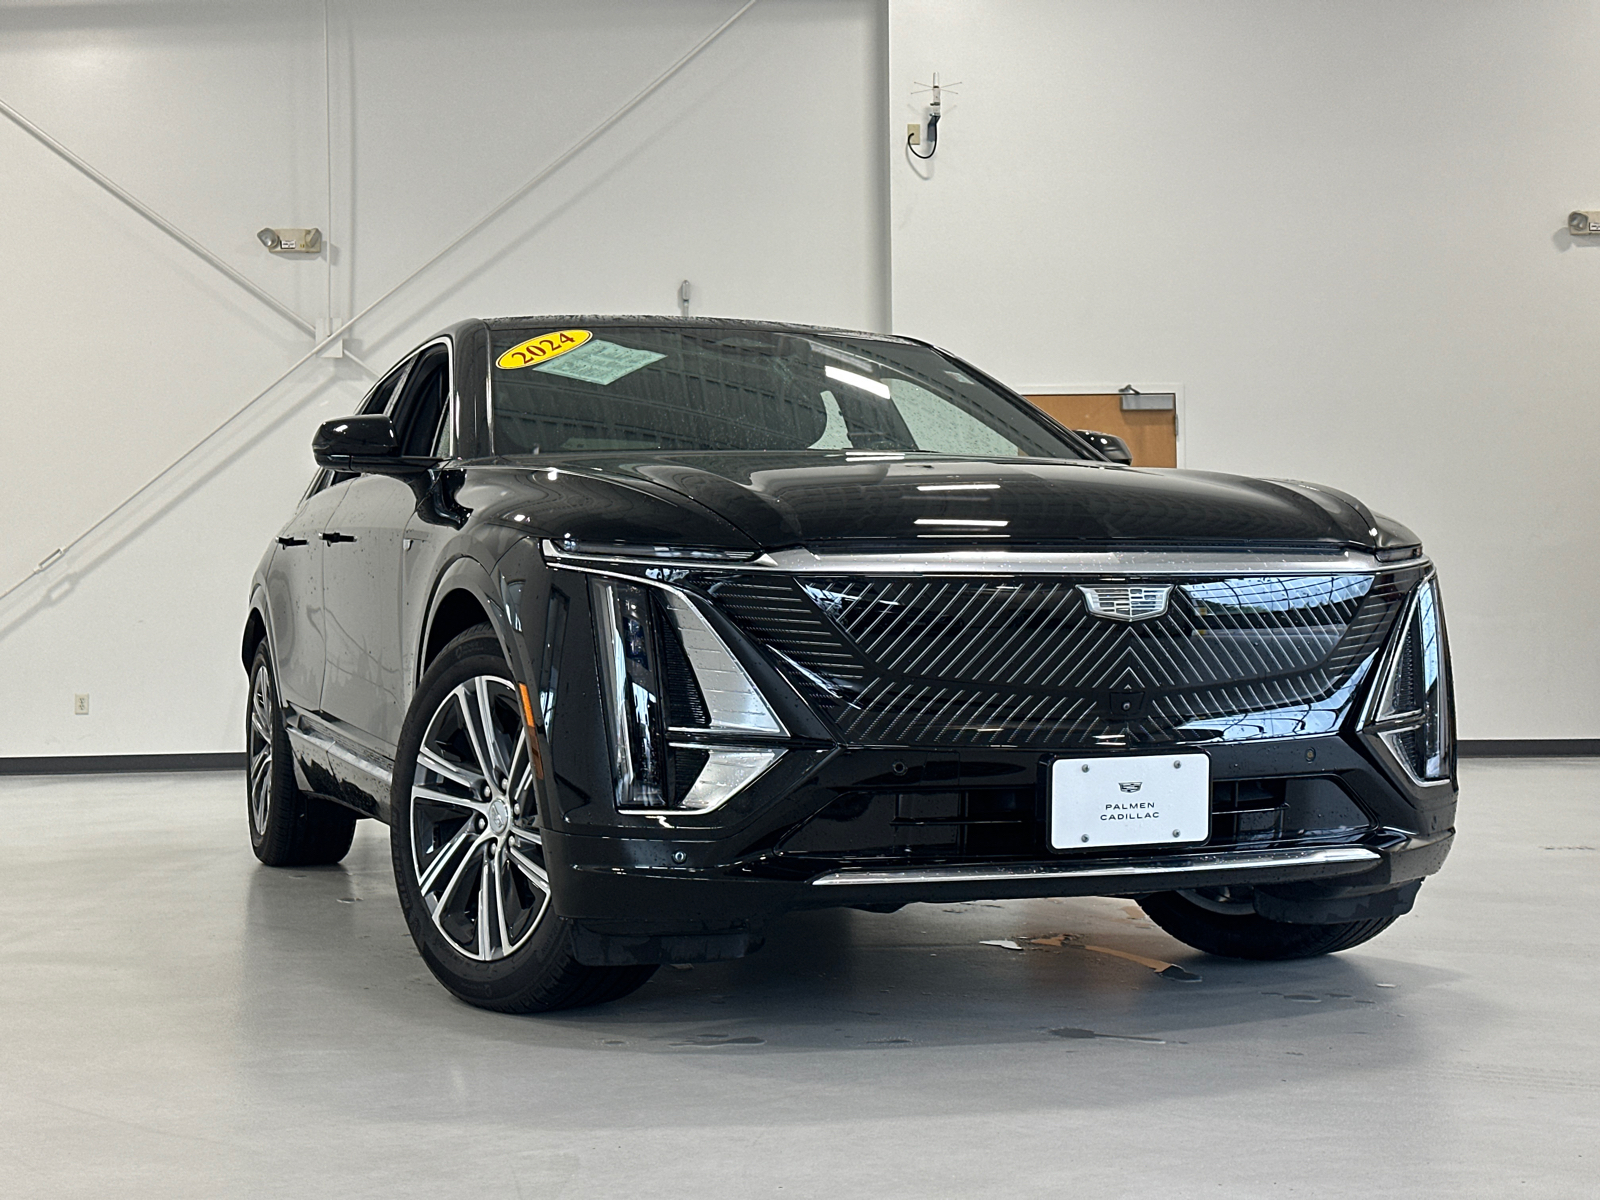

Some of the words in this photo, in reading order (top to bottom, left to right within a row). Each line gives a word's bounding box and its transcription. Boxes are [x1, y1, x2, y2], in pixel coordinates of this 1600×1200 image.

[511, 333, 576, 364] 2024
[1105, 802, 1155, 810] PALMEN
[1100, 812, 1160, 821] CADILLAC
